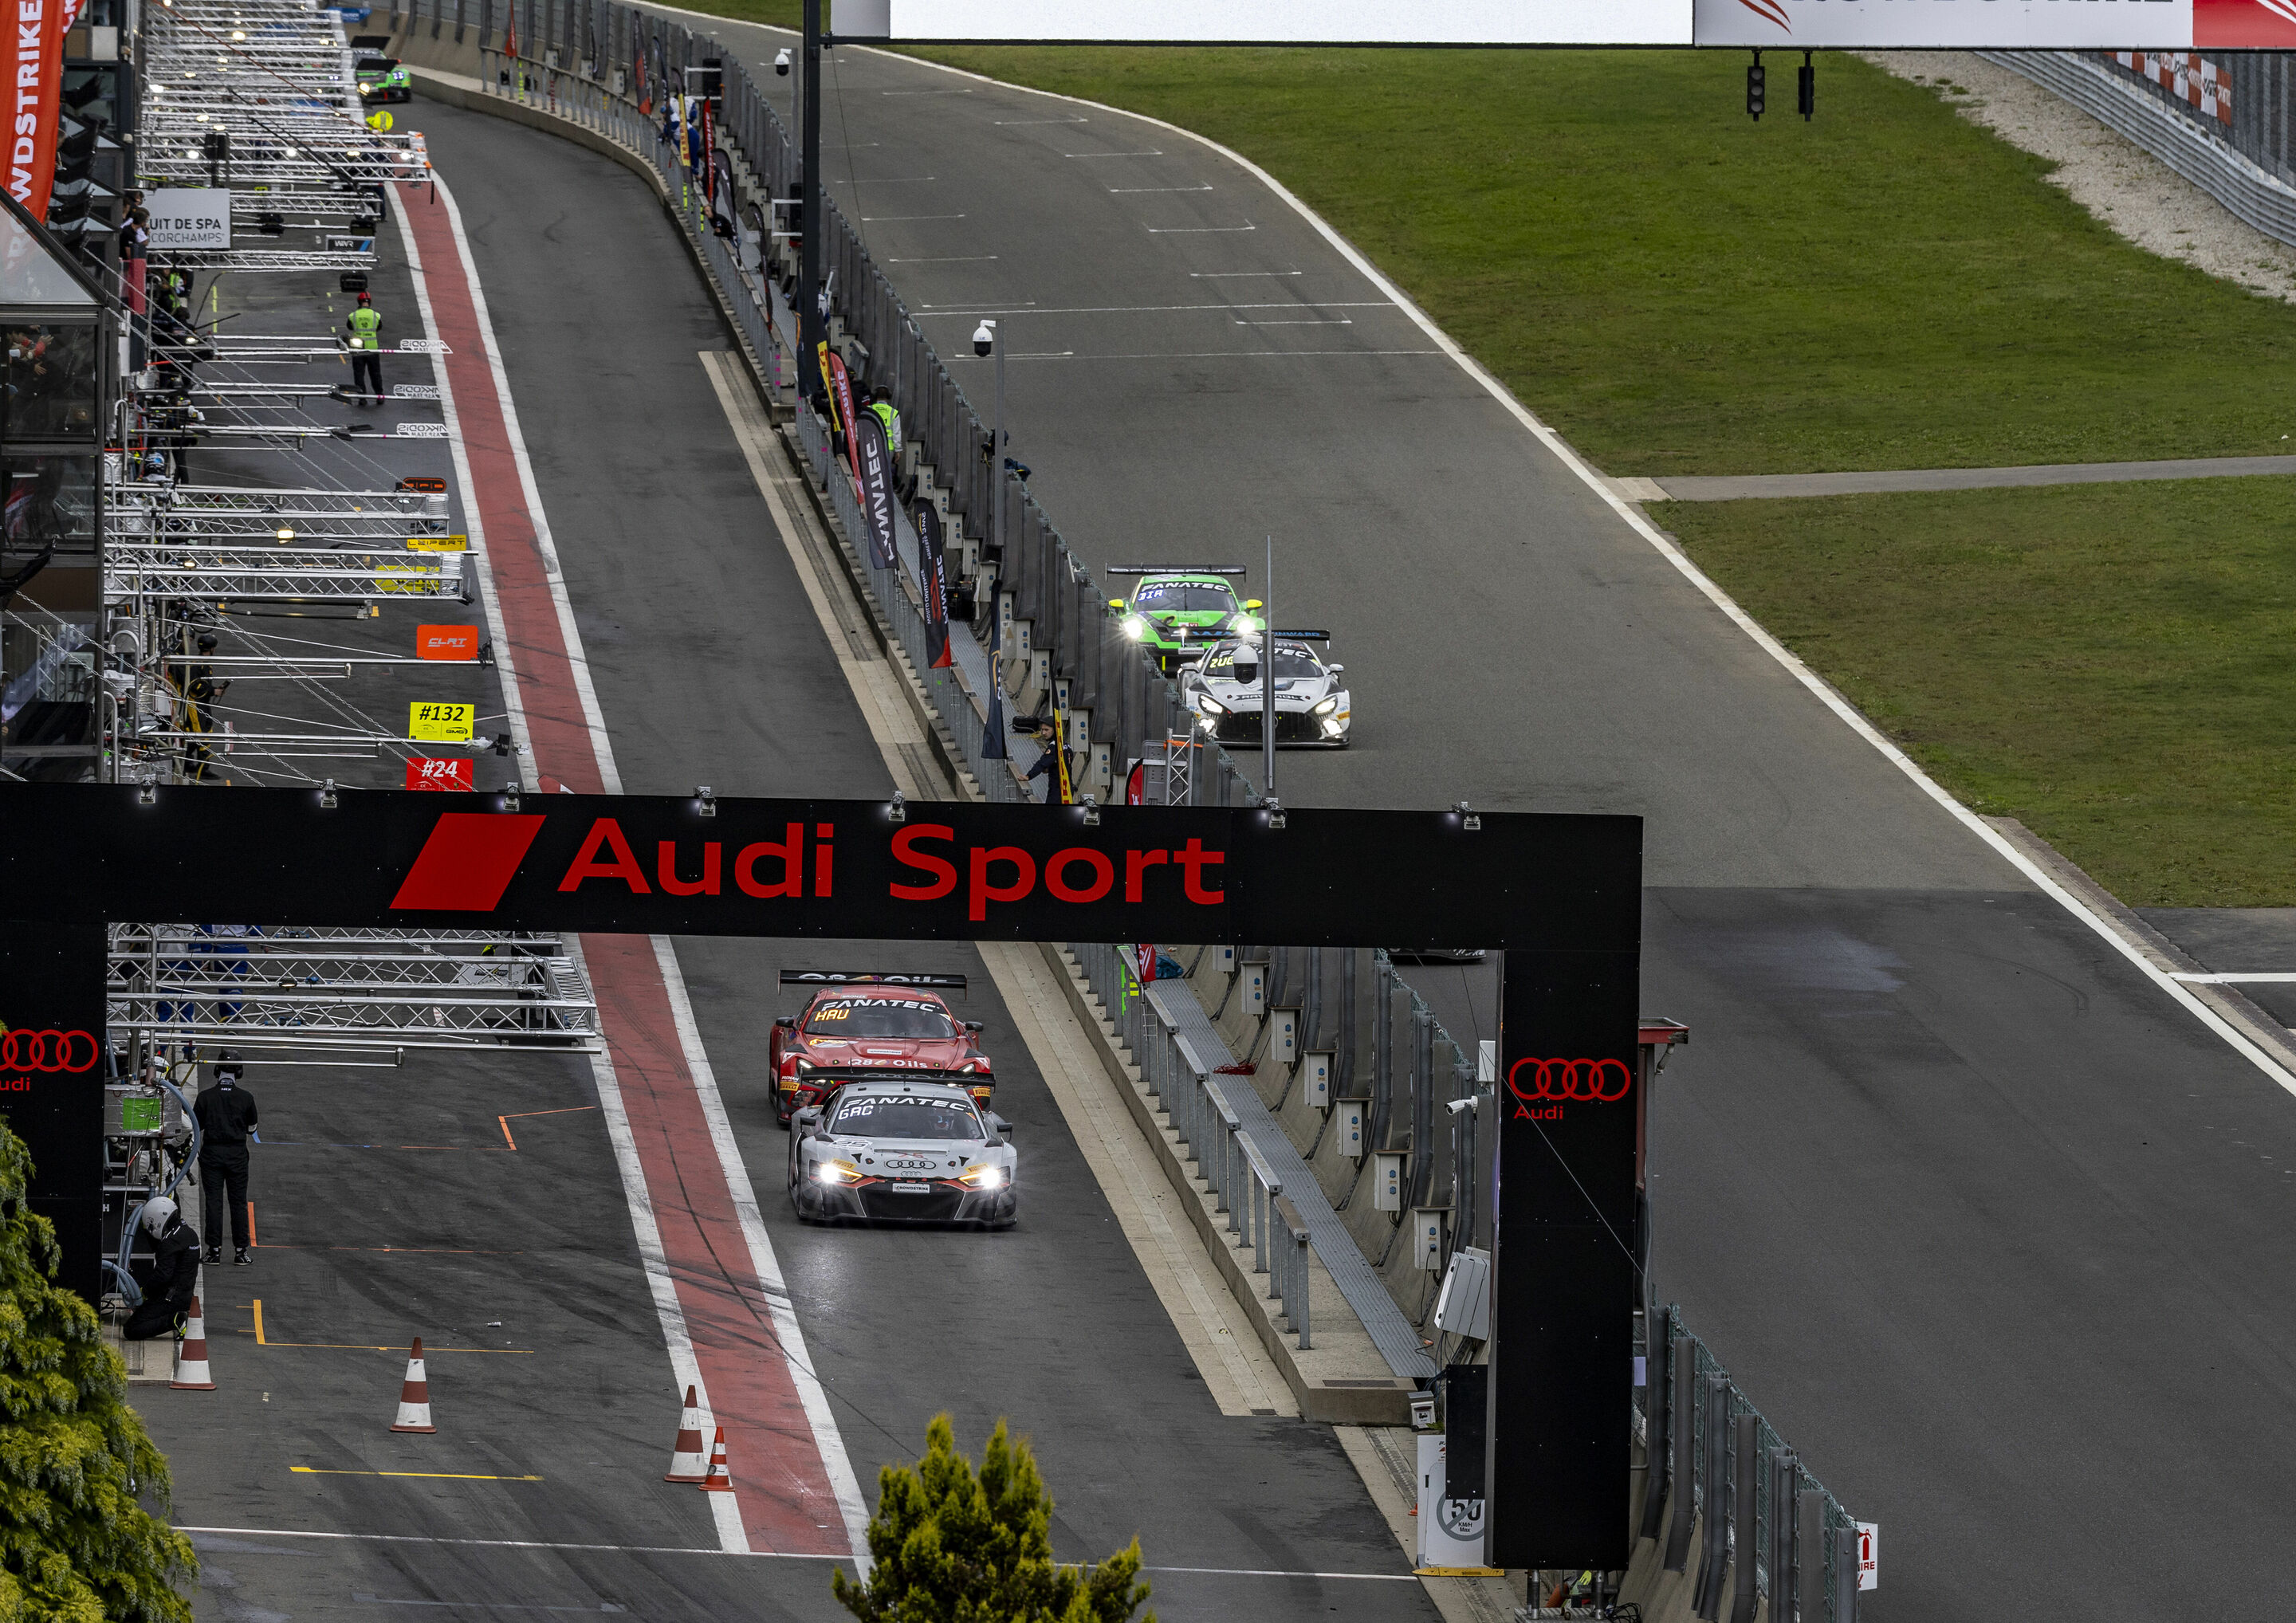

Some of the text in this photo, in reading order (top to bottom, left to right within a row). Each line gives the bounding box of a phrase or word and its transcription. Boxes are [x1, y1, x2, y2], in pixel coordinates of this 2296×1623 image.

[175, 218, 192, 230] DE
[196, 218, 222, 230] SPA
[1141, 582, 1229, 592] FANATEC
[419, 705, 465, 721] #132
[421, 760, 458, 778] #24
[557, 817, 1225, 922] Audi Sport
[822, 999, 937, 1012] FANATEC
[847, 1058, 928, 1068] Q8 Oils
[0, 1077, 31, 1091] udi
[844, 1097, 968, 1111] FANATEC
[1514, 1106, 1563, 1119] Audi
[1860, 1561, 1875, 1571] IRE
